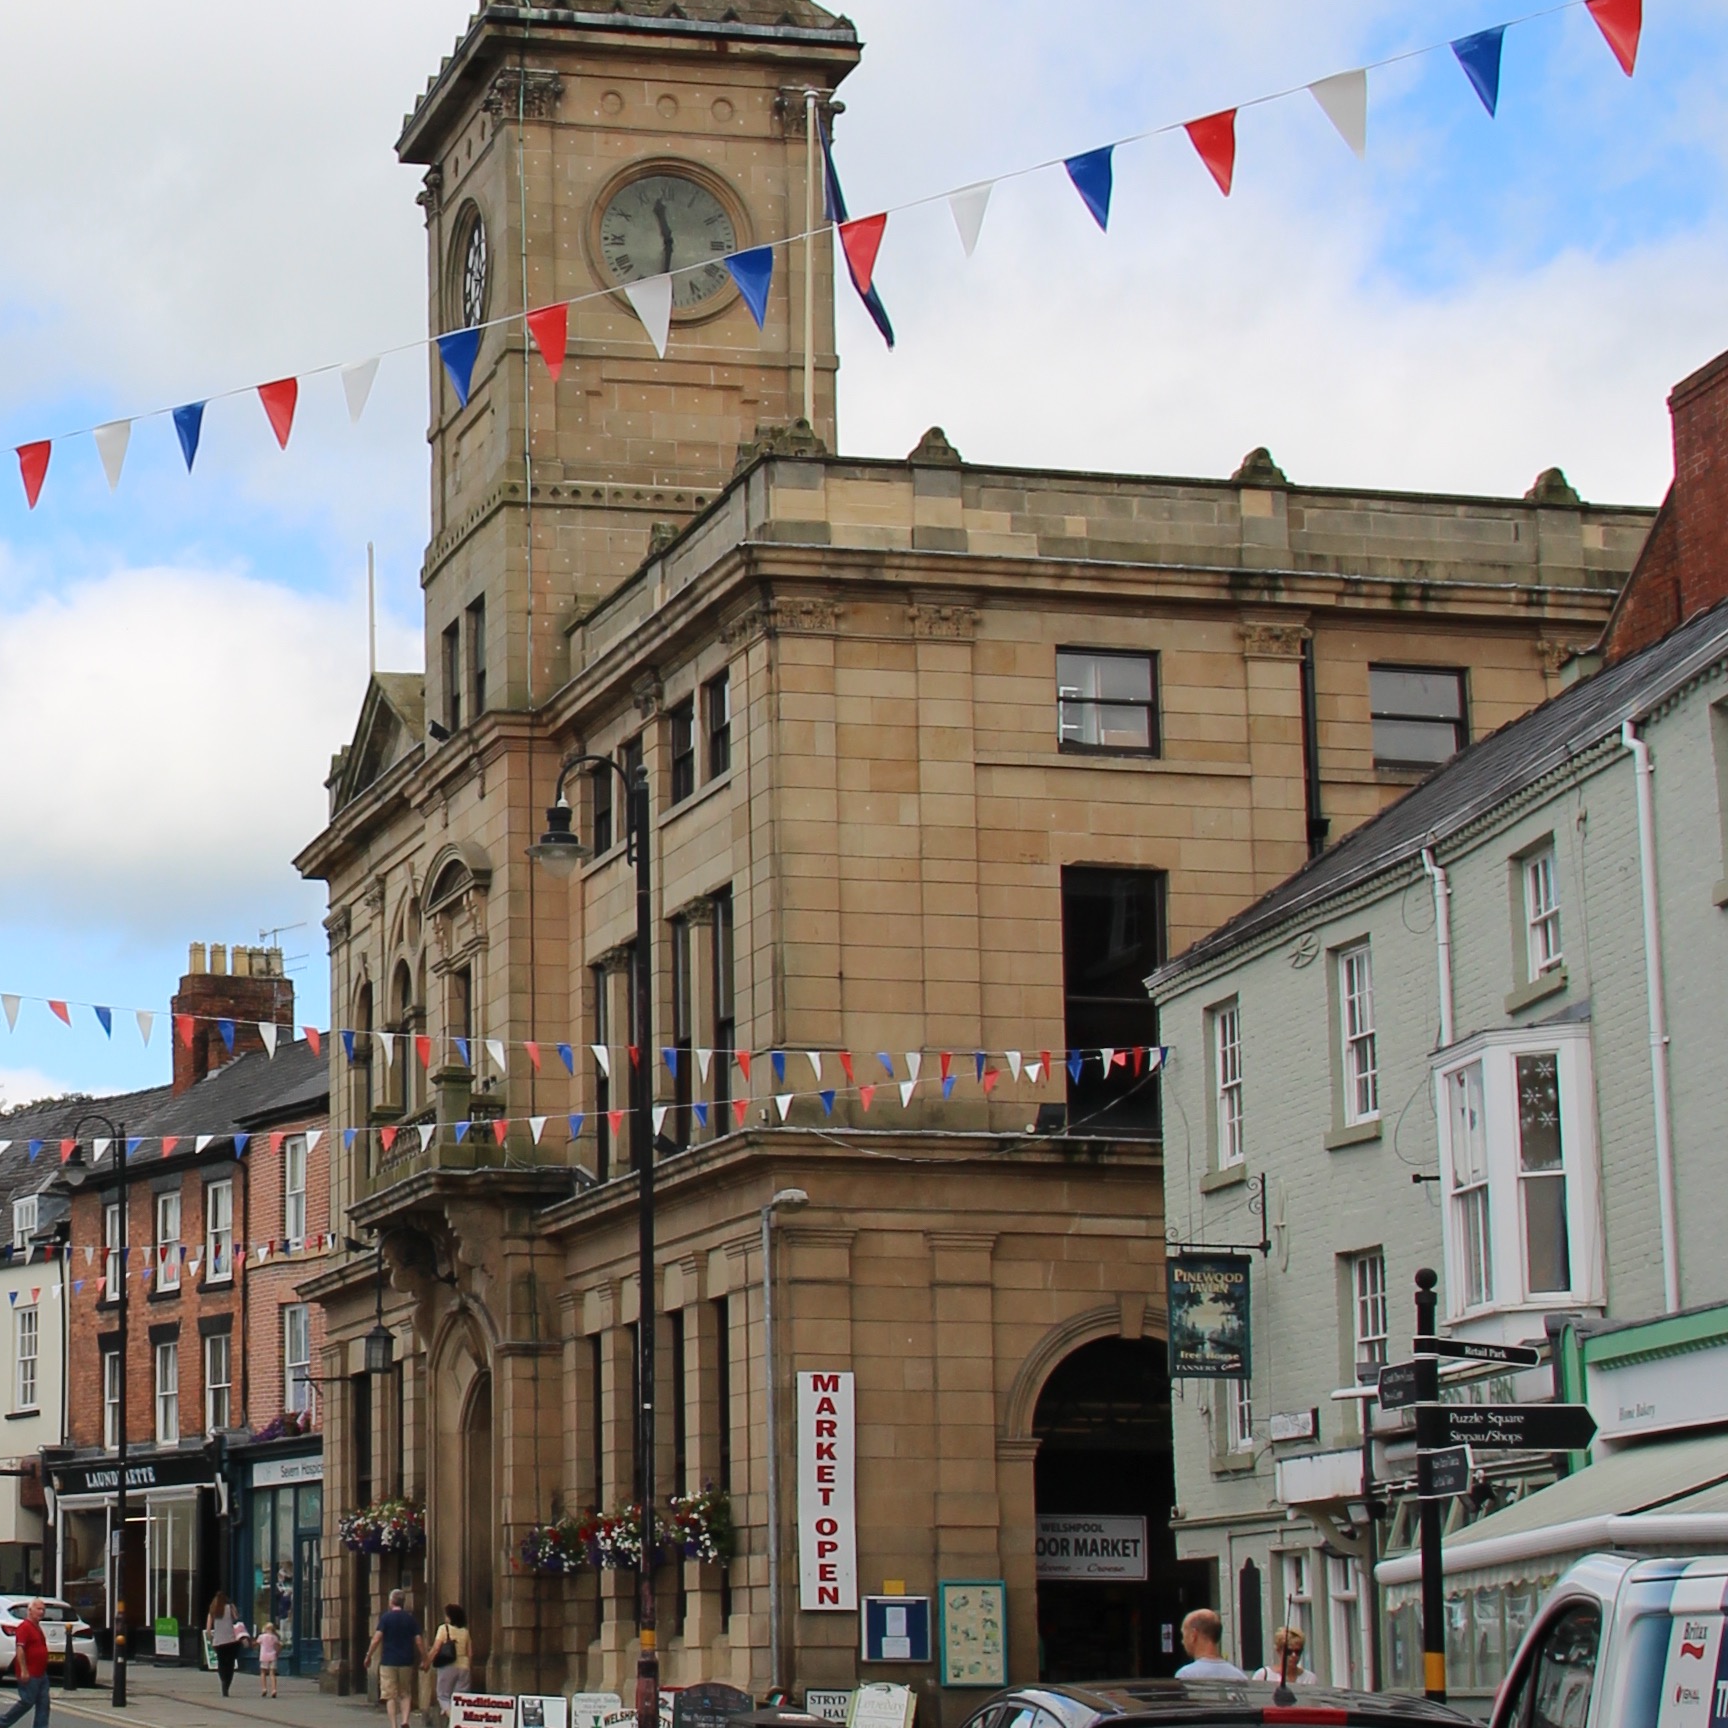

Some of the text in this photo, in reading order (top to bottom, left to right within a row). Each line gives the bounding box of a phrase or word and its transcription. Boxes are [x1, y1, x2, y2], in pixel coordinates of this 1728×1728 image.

[1173, 1268, 1244, 1284] PINEWOOD
[1189, 1282, 1229, 1293] TAVERN
[1464, 1345, 1507, 1360] Retail Park
[1449, 1412, 1525, 1427] Puzzle Square
[1449, 1430, 1523, 1445] Siopau/Shops
[810, 1374, 841, 1605] MARKET OPEN
[1040, 1521, 1105, 1533] WELSHPOOL
[1036, 1537, 1141, 1558] OOR MARKET
[1683, 1621, 1709, 1641] Britax
[453, 1695, 515, 1710] Traditional
[809, 1695, 848, 1706] STRYD
[463, 1710, 503, 1724] Market
[823, 1708, 849, 1719] HAL
